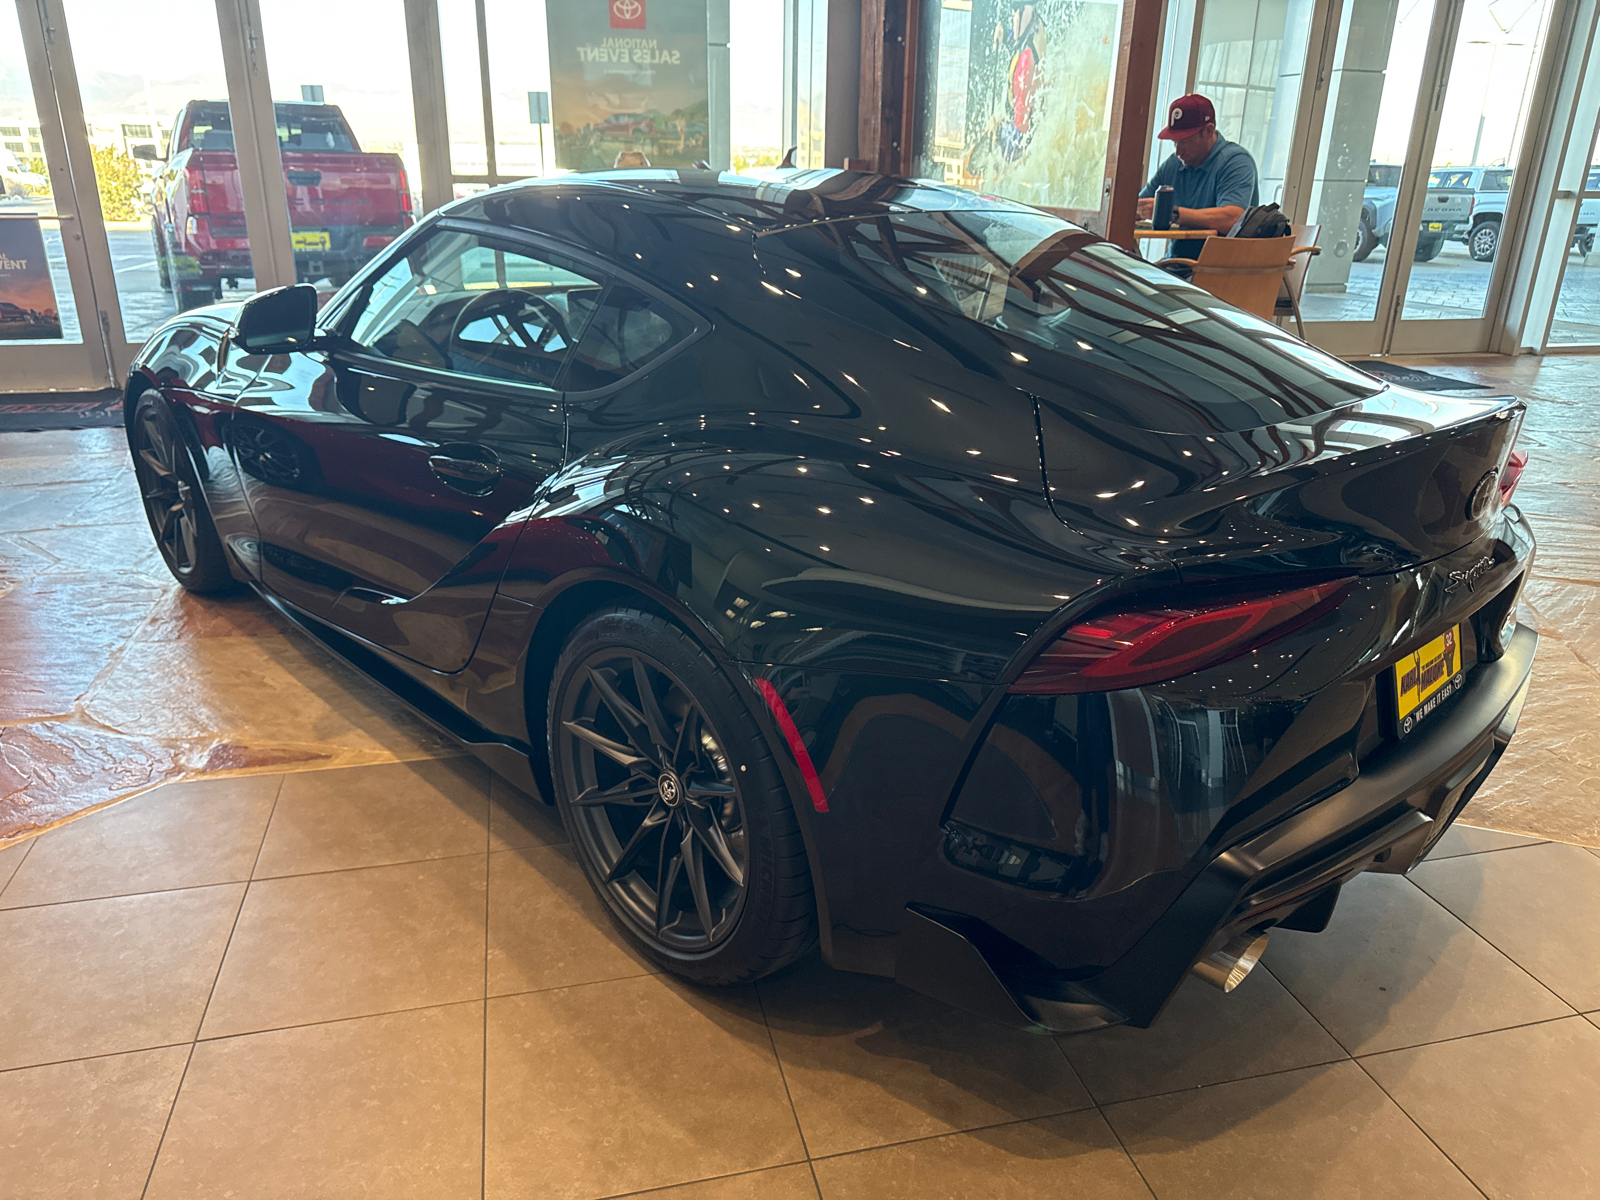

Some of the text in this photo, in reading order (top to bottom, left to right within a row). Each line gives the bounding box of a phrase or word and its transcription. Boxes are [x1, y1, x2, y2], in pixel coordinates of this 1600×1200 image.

[1171, 107, 1183, 127] P
[1416, 683, 1452, 722] WE MAKE IT EASY
